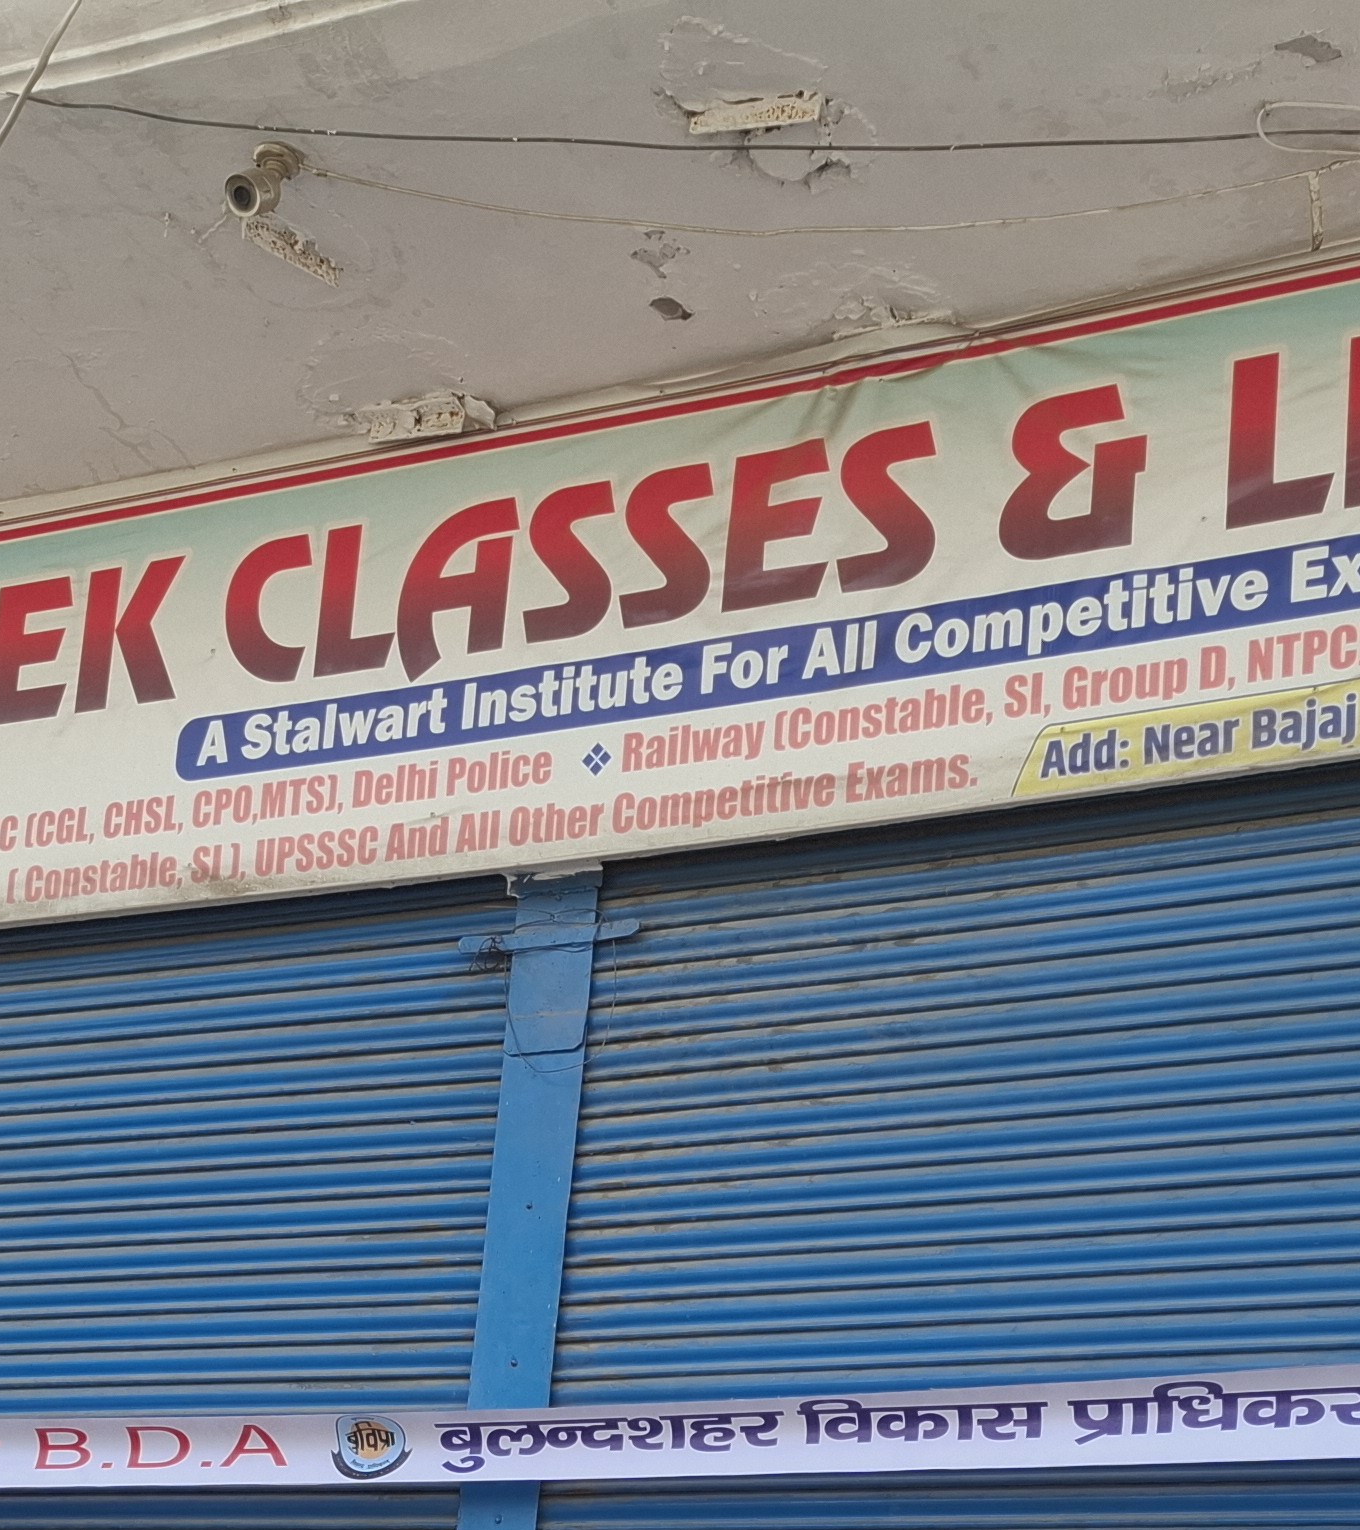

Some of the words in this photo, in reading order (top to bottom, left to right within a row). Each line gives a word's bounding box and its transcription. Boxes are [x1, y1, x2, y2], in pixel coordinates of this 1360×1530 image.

[224, 419, 938, 684] CLASSES
[997, 382, 1148, 560] &
[196, 721, 228, 767] A
[241, 688, 447, 760] Stalwart
[461, 656, 683, 729] Institute
[700, 642, 788, 695] For
[802, 622, 877, 680] All
[895, 567, 1268, 663] Competitive
[620, 724, 767, 773] Railway
[1003, 671, 1052, 720] SI,
[1063, 656, 1188, 711] Group
[1199, 645, 1236, 691] D,
[1040, 728, 1132, 779] Add:
[1143, 714, 1240, 766] Near
[1251, 692, 1358, 751] Bajaj
[24, 852, 183, 902] Constable,
[255, 825, 378, 877] UPSSSC
[385, 817, 440, 862] And
[456, 810, 500, 853] All
[509, 802, 605, 847] Other
[612, 771, 836, 833] Competitive
[846, 754, 978, 802] Exams.
[103, 795, 184, 839] CHSL,
[352, 761, 438, 809] Delhi
[445, 749, 554, 800] Police
[34, 1423, 288, 1471] B.D.A
[434, 1410, 785, 1474] बुलन्दशहर
[797, 1398, 1048, 1444] विकास
